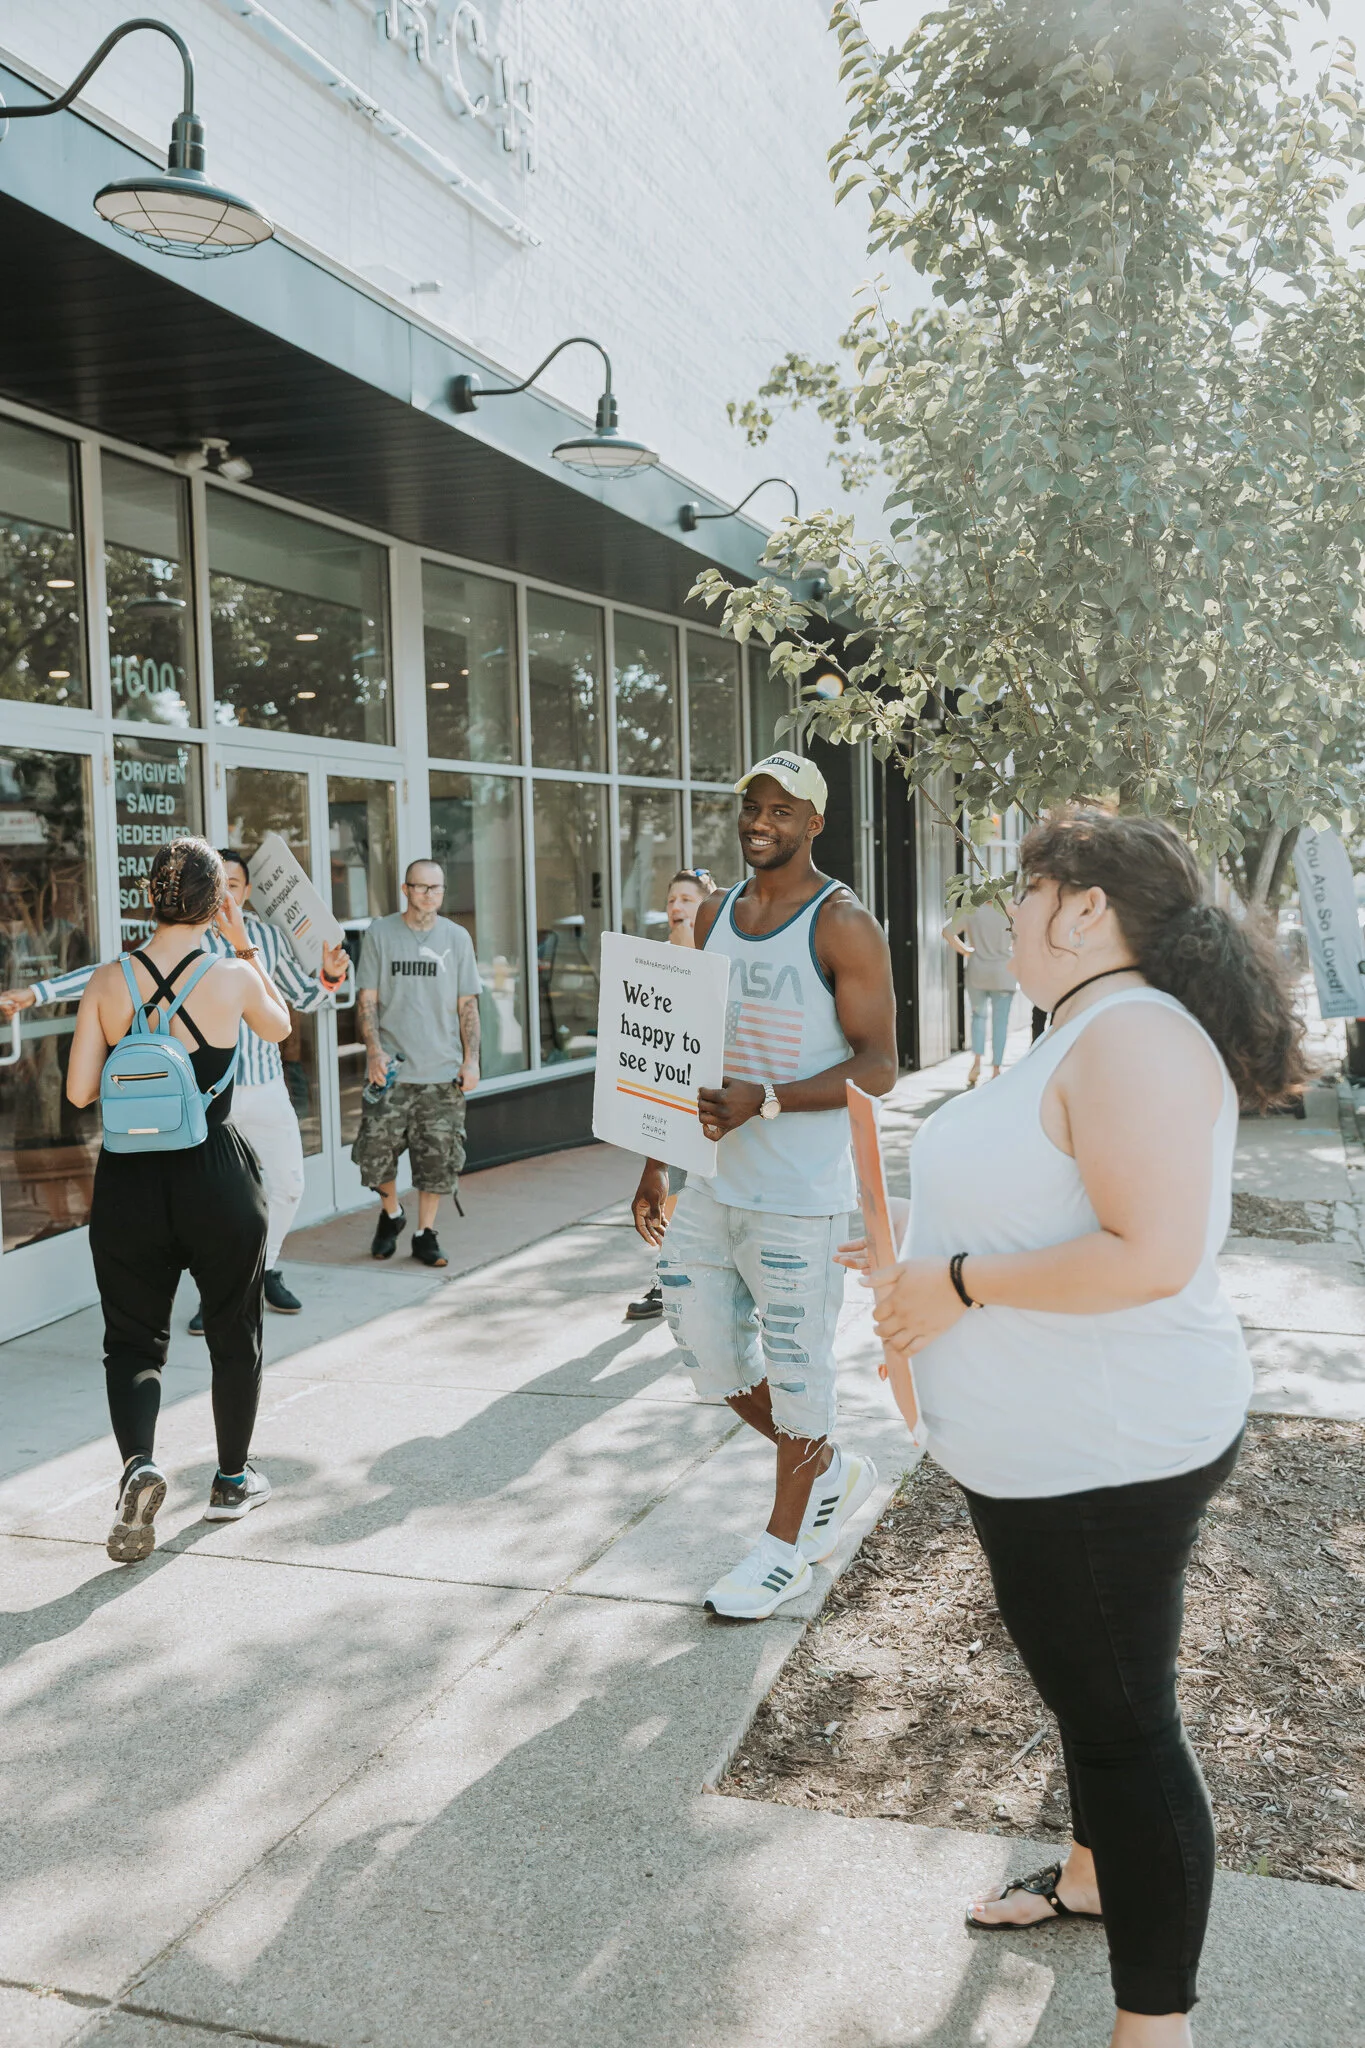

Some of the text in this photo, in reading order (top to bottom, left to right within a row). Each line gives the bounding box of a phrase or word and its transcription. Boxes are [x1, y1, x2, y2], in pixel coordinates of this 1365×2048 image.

[111, 655, 177, 700] 1600
[114, 760, 187, 784] FORGIVEN
[782, 759, 799, 771] FAITH
[126, 793, 176, 815] SAVED
[1305, 835, 1320, 868] You
[257, 879, 274, 895] You
[272, 865, 284, 881] are
[1313, 874, 1326, 903] Are
[120, 888, 140, 909] SO
[265, 874, 300, 918] unstoppable
[1317, 908, 1332, 932] So
[391, 961, 437, 977] PUMA
[1320, 937, 1345, 995] Loved!
[622, 980, 673, 1013] We're
[620, 1013, 701, 1055] happy to
[619, 1051, 692, 1087] see you!
[641, 1122, 666, 1136] CHURCH
[643, 1113, 668, 1125] AMPLIFY
